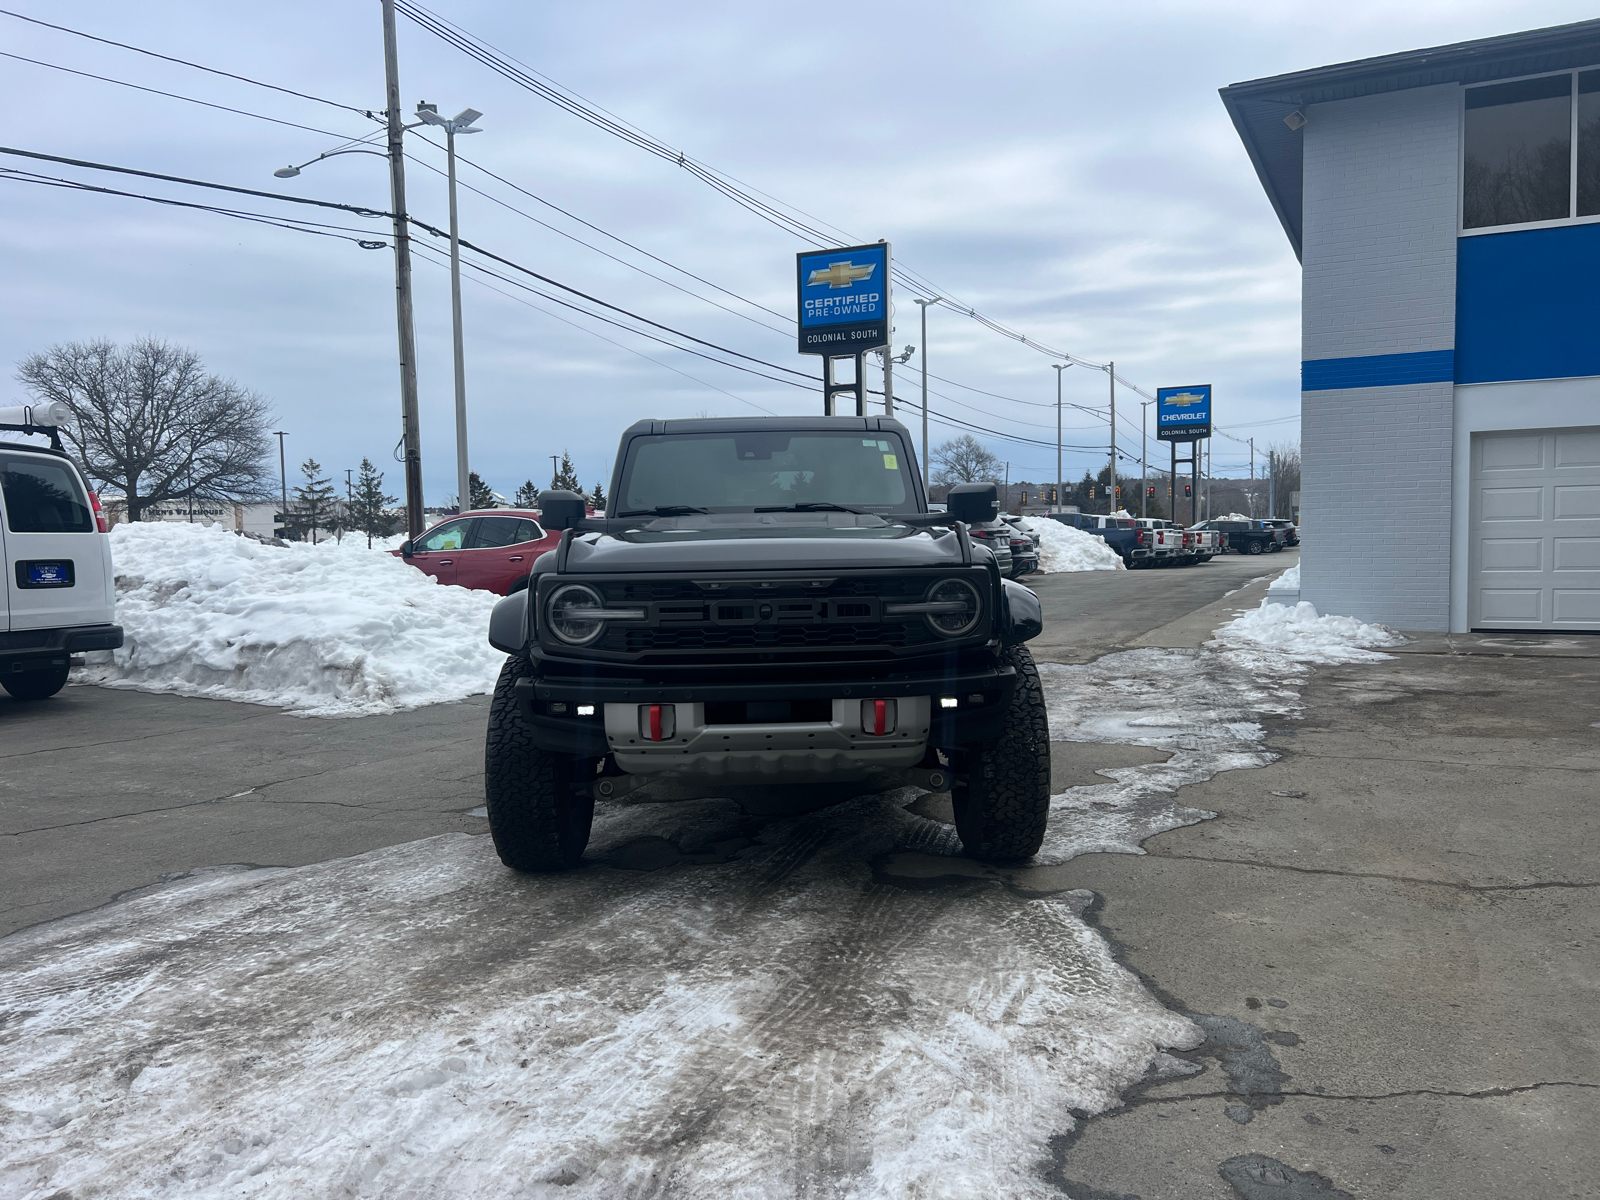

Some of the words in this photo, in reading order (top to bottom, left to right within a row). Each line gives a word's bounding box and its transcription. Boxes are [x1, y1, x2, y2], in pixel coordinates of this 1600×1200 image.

[804, 293, 880, 309] CERTIFIED
[808, 303, 876, 318] PRE-OWNED
[807, 332, 847, 343] COLONIAL
[851, 329, 878, 340] SOUTH
[1161, 412, 1207, 422] CHEVROLET
[651, 596, 881, 628] FORD
